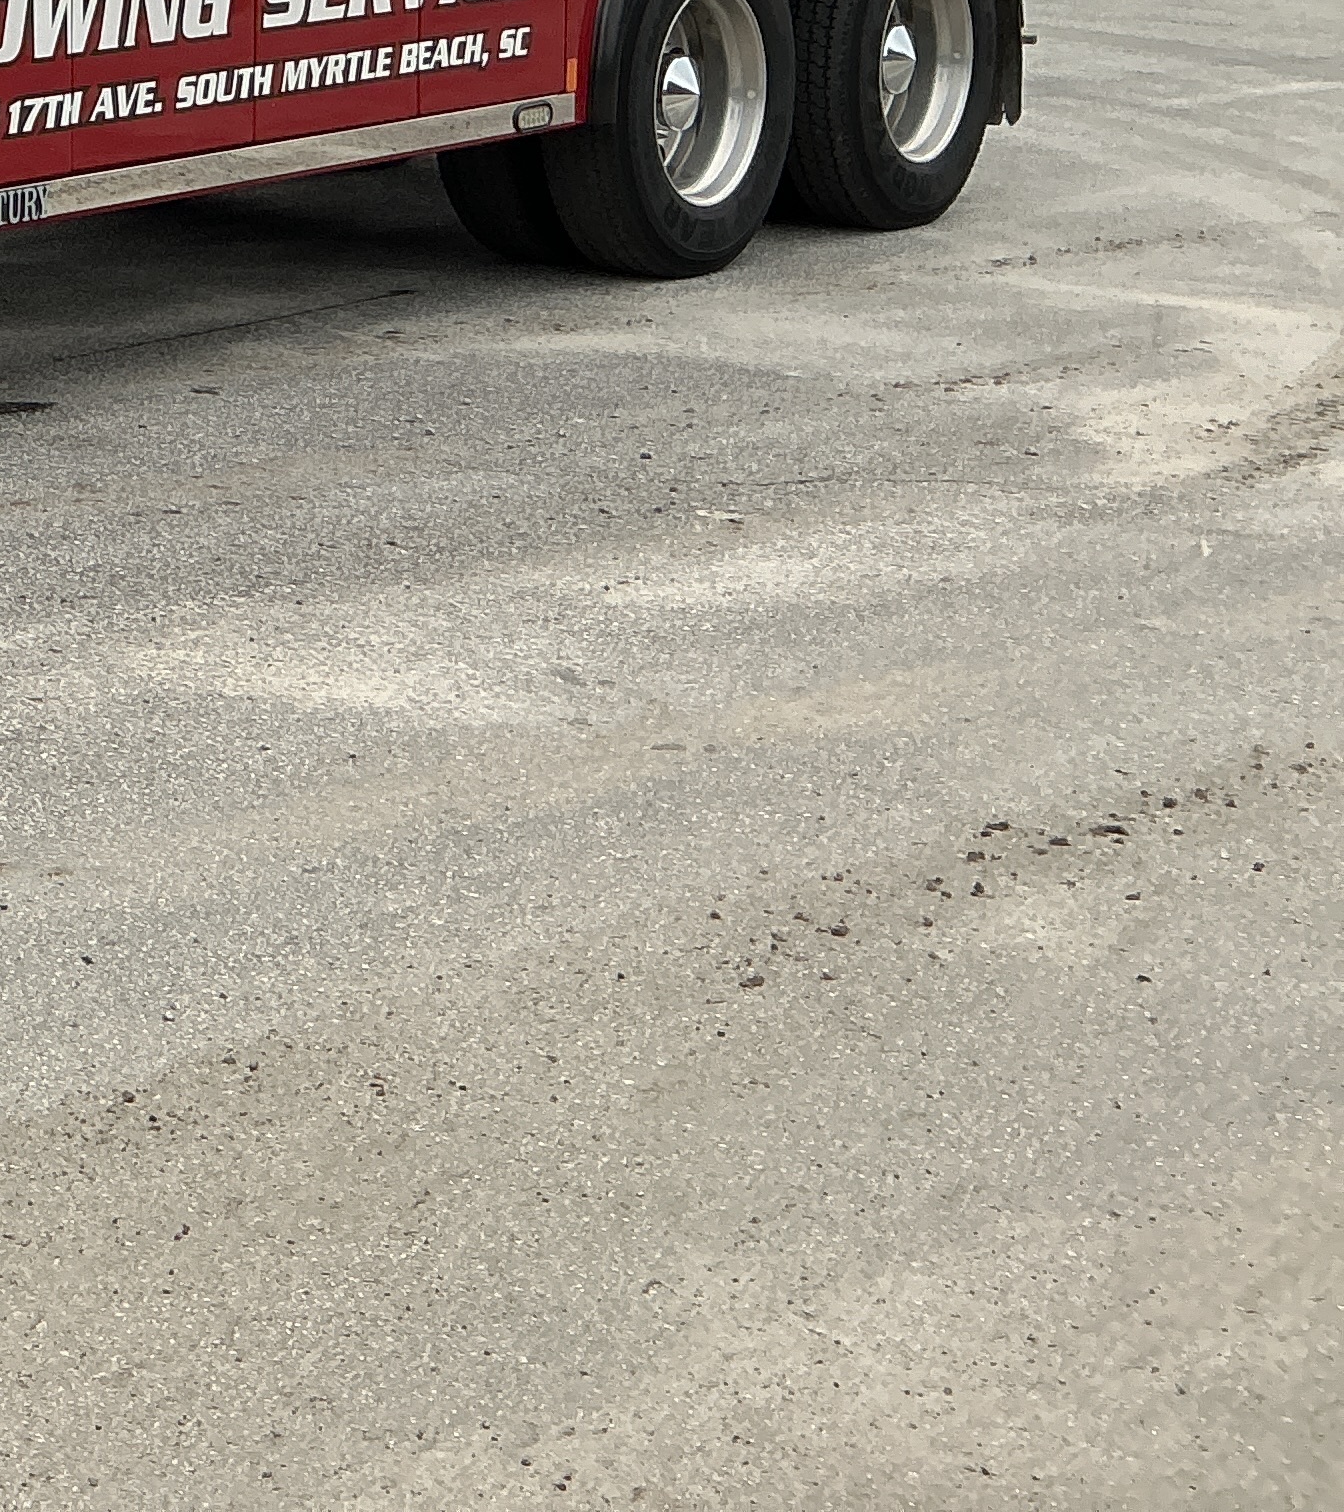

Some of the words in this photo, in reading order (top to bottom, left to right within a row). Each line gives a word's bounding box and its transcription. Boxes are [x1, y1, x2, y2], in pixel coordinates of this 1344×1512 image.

[8, 90, 84, 136] 17TH
[89, 80, 163, 123] AVE.
[175, 64, 274, 110] SOUTH
[281, 46, 393, 93] MYRTLE
[399, 32, 491, 75] BEACH,
[498, 26, 531, 59] SC
